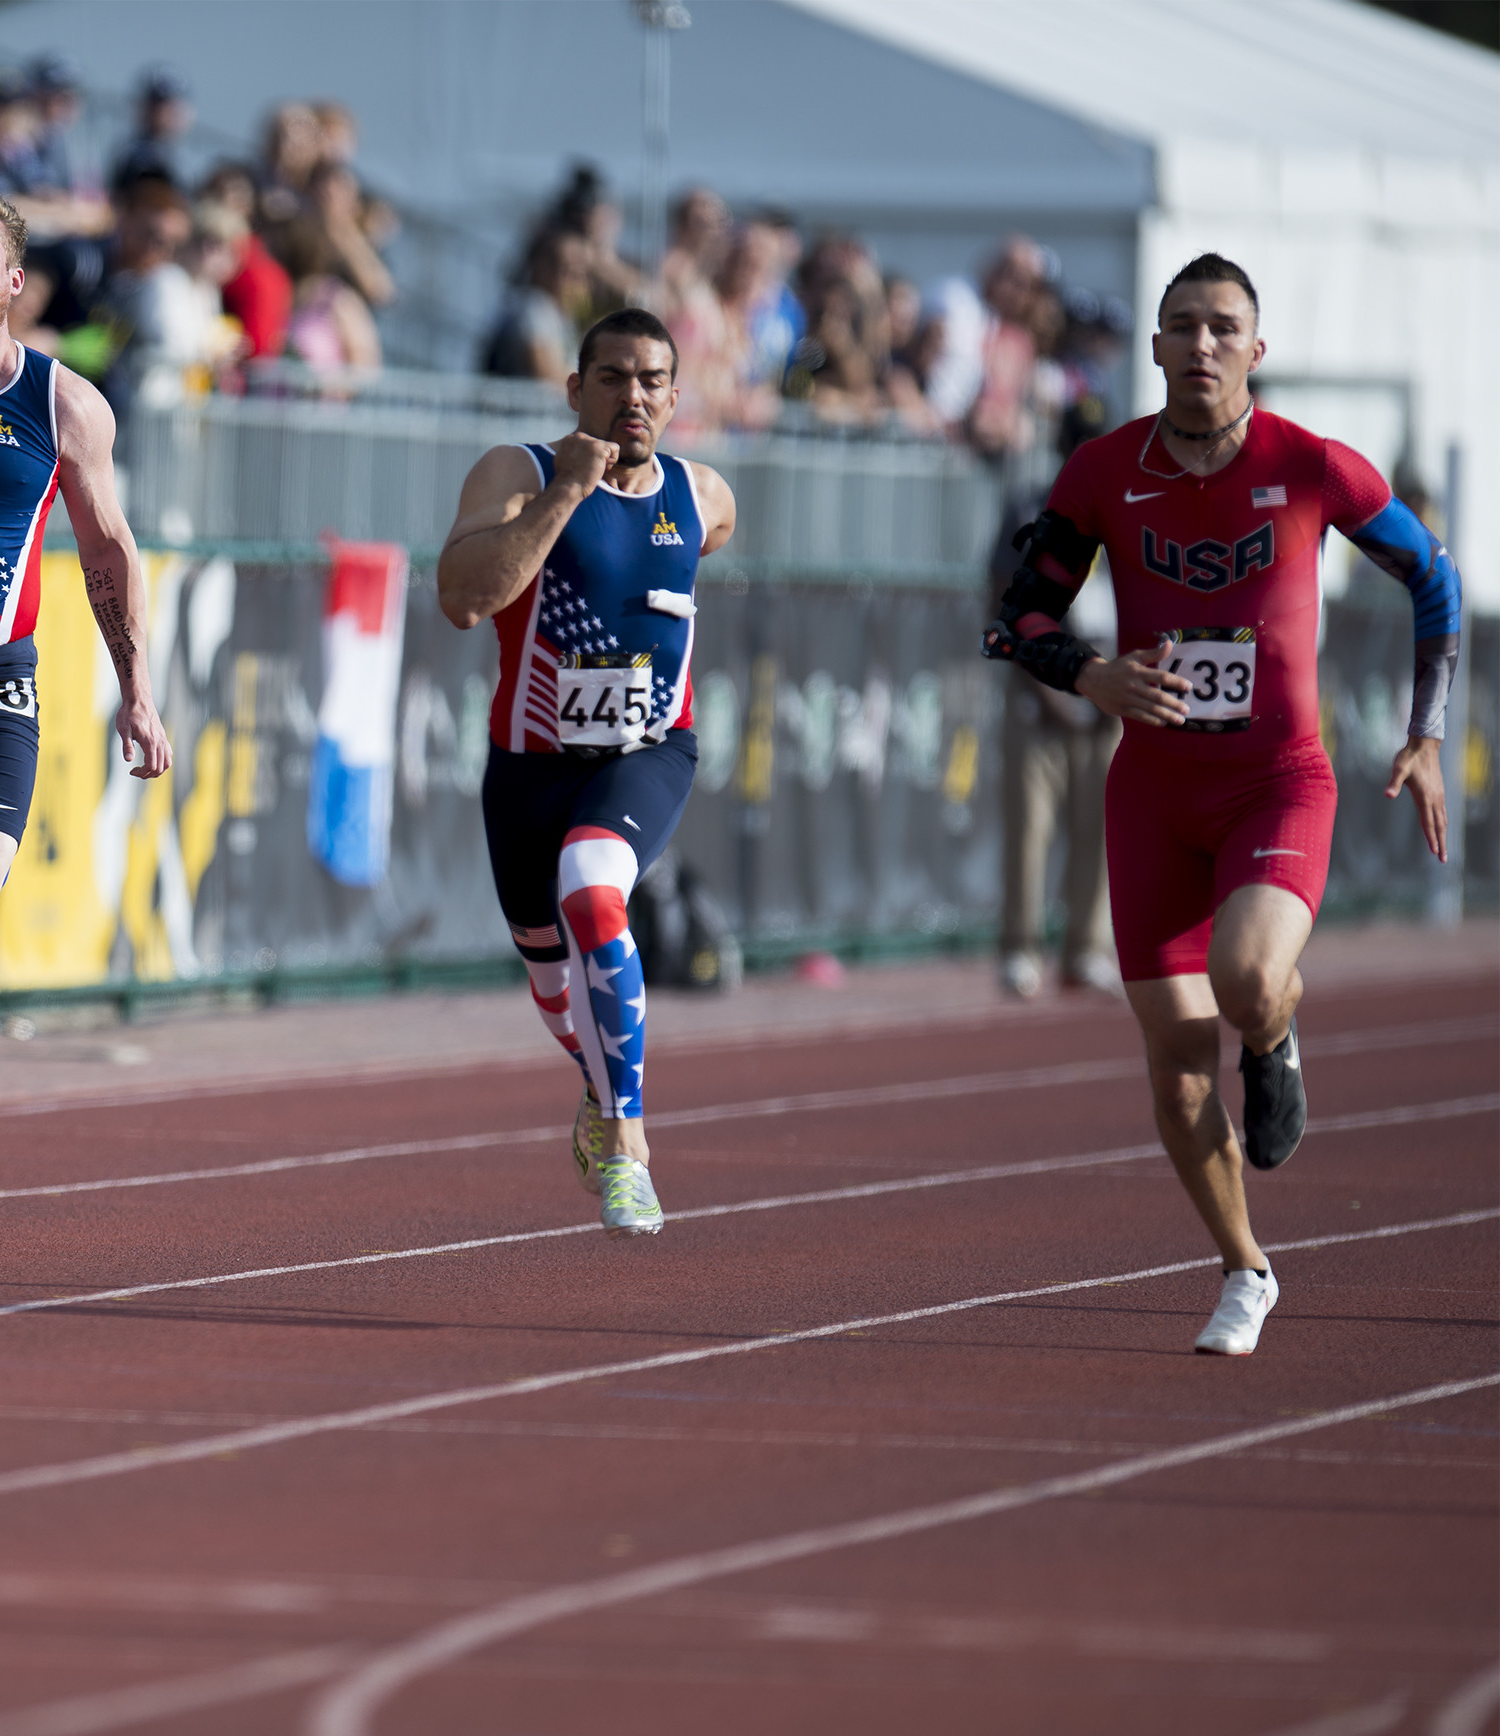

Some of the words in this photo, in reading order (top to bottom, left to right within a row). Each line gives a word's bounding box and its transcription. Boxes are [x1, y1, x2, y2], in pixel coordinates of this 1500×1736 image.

[653, 522, 677, 534] AM
[659, 512, 667, 523] I
[651, 533, 684, 546] USA
[1141, 520, 1275, 593] USA
[92, 570, 103, 592] CPL
[103, 567, 115, 592] SGT
[108, 597, 124, 622] BRAD
[1161, 657, 1252, 704] 433
[560, 686, 648, 729] 445
